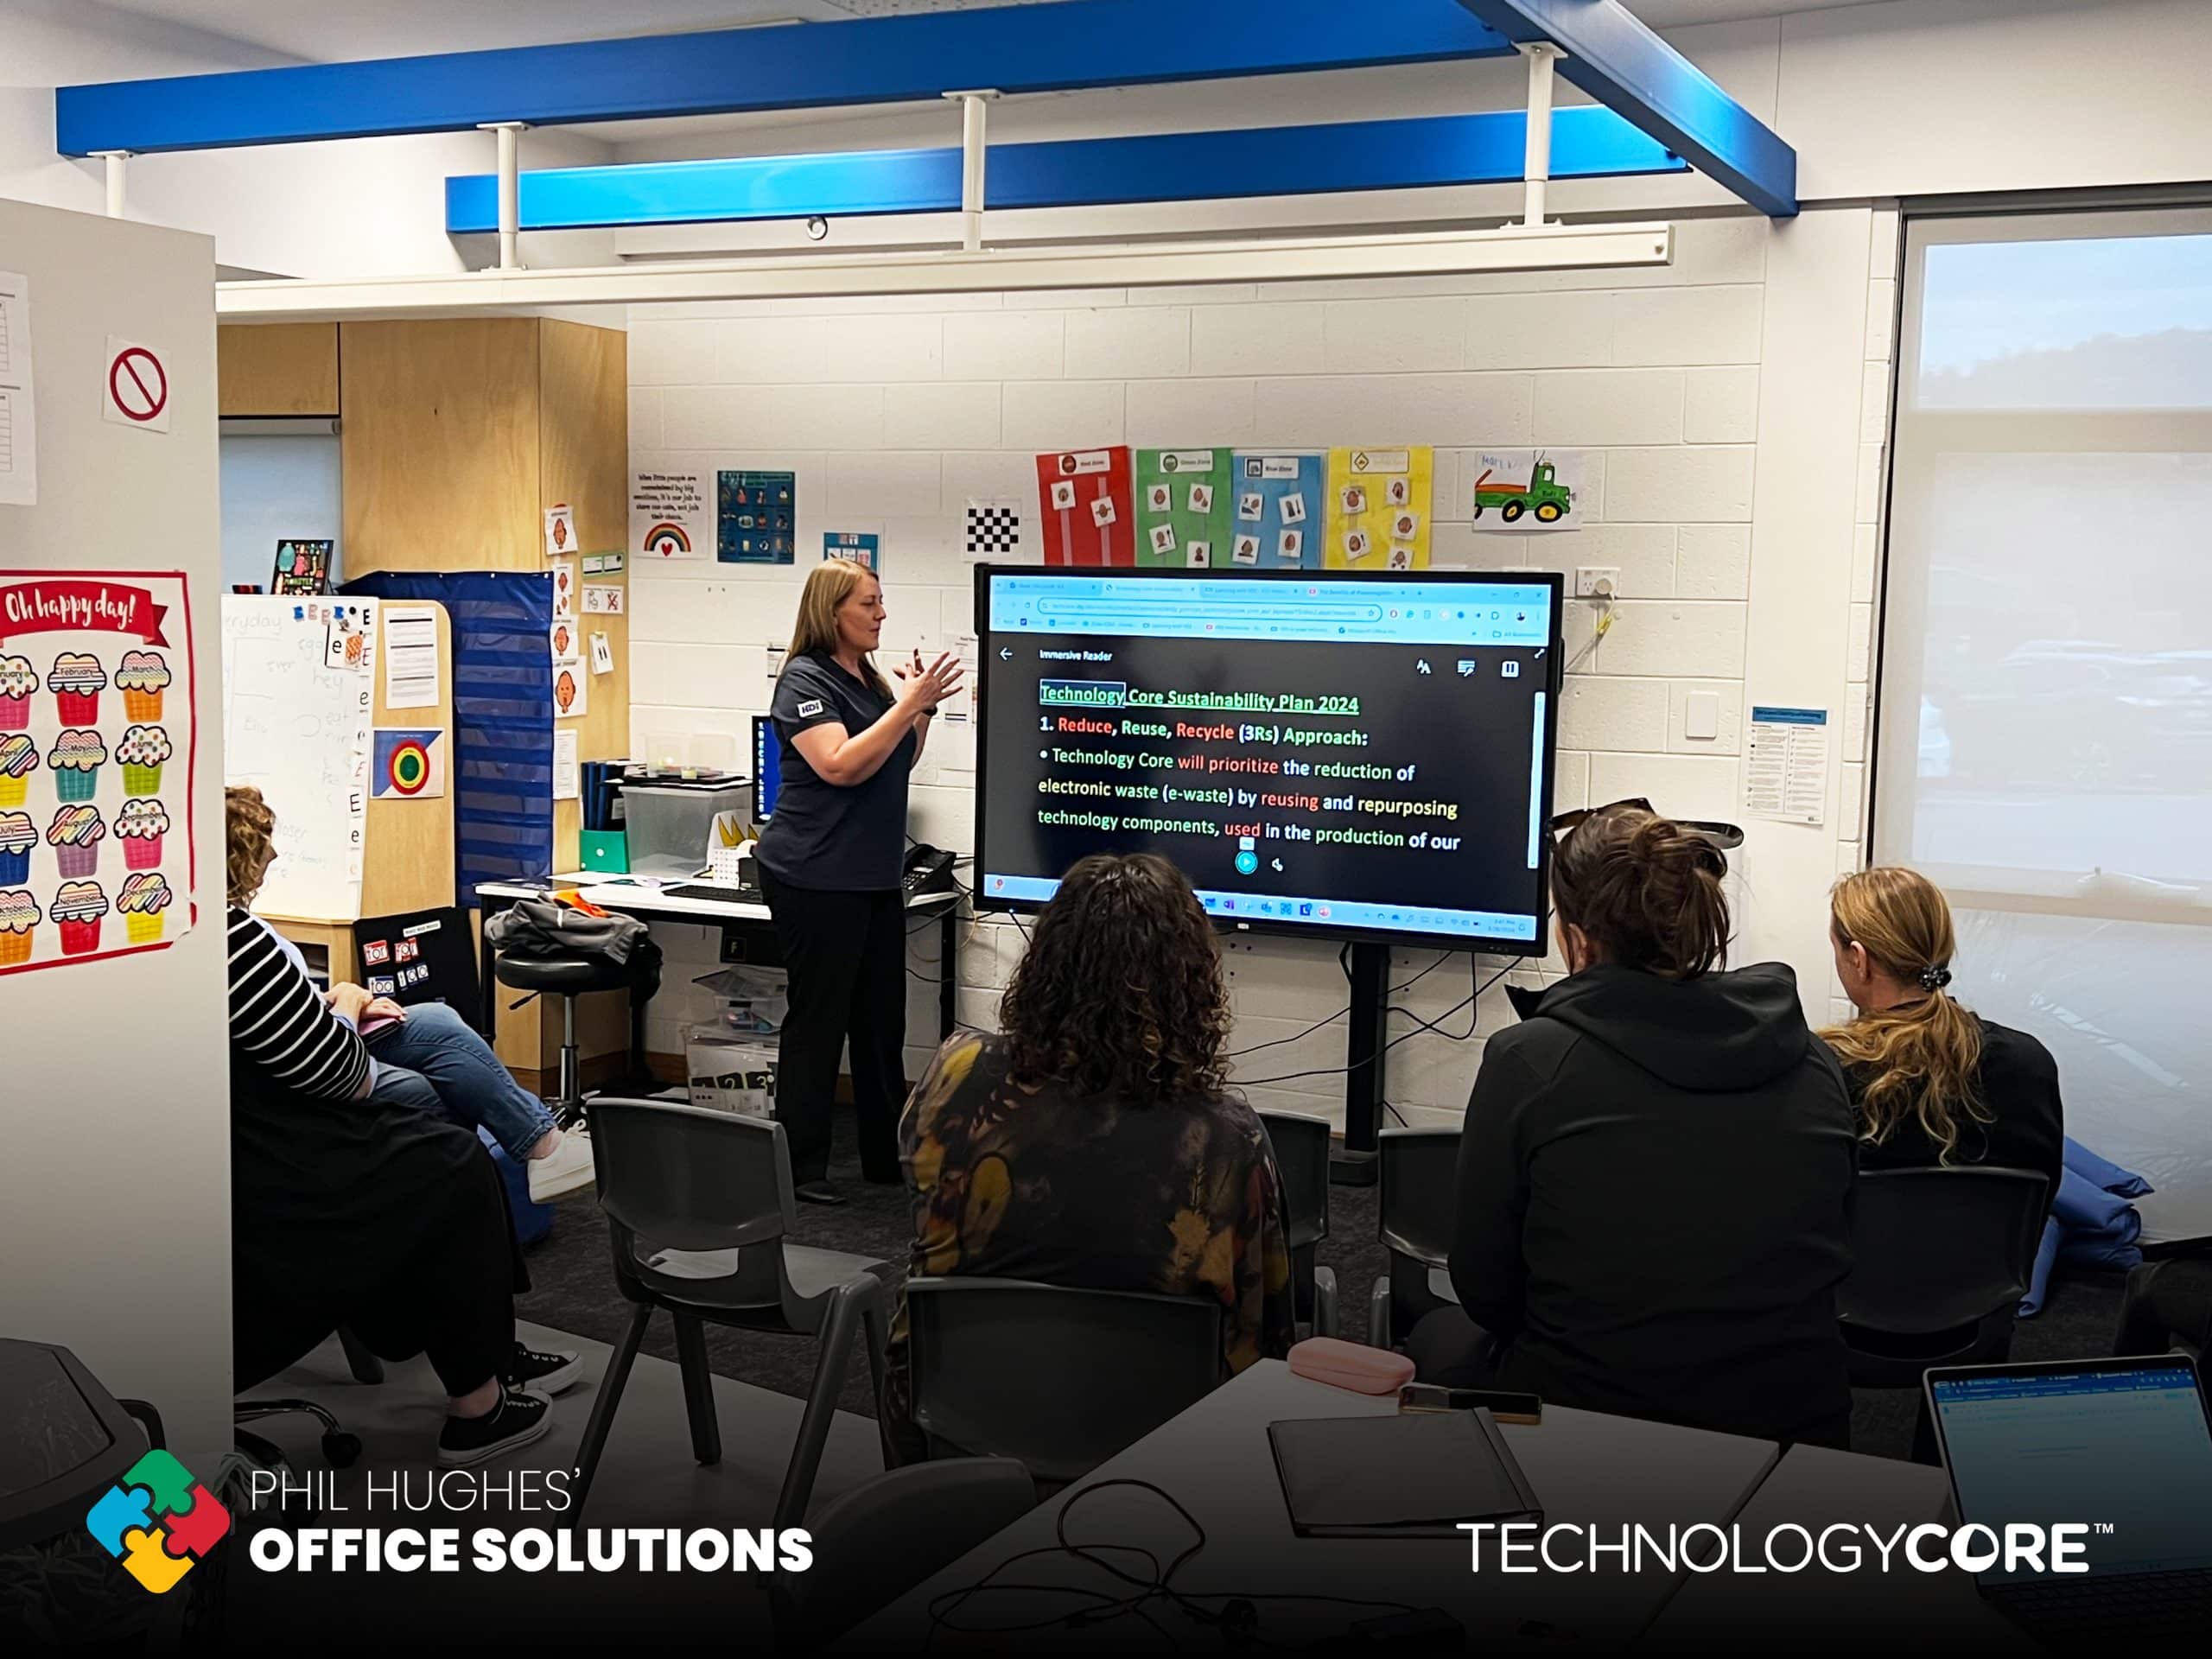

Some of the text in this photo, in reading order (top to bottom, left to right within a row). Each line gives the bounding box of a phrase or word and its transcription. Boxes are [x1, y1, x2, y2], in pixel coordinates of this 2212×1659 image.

[5, 588, 137, 631] Oh happy day!
[1039, 649, 1113, 662] Immersive Reader
[60, 668, 93, 677] February
[1041, 684, 1359, 714] Technology Core Sustainability Plan 2024
[1039, 715, 1369, 747] 1. Reduce, Reuse, Recycle (3Rs) Approach:
[1052, 747, 1416, 781] Technology Core will prioritize the reduction of
[1038, 778, 1459, 820] electronic waste (e-waste) by reusing and repurposing
[1038, 810, 1461, 850] technology components, used in the production of our
[60, 895, 99, 906] November
